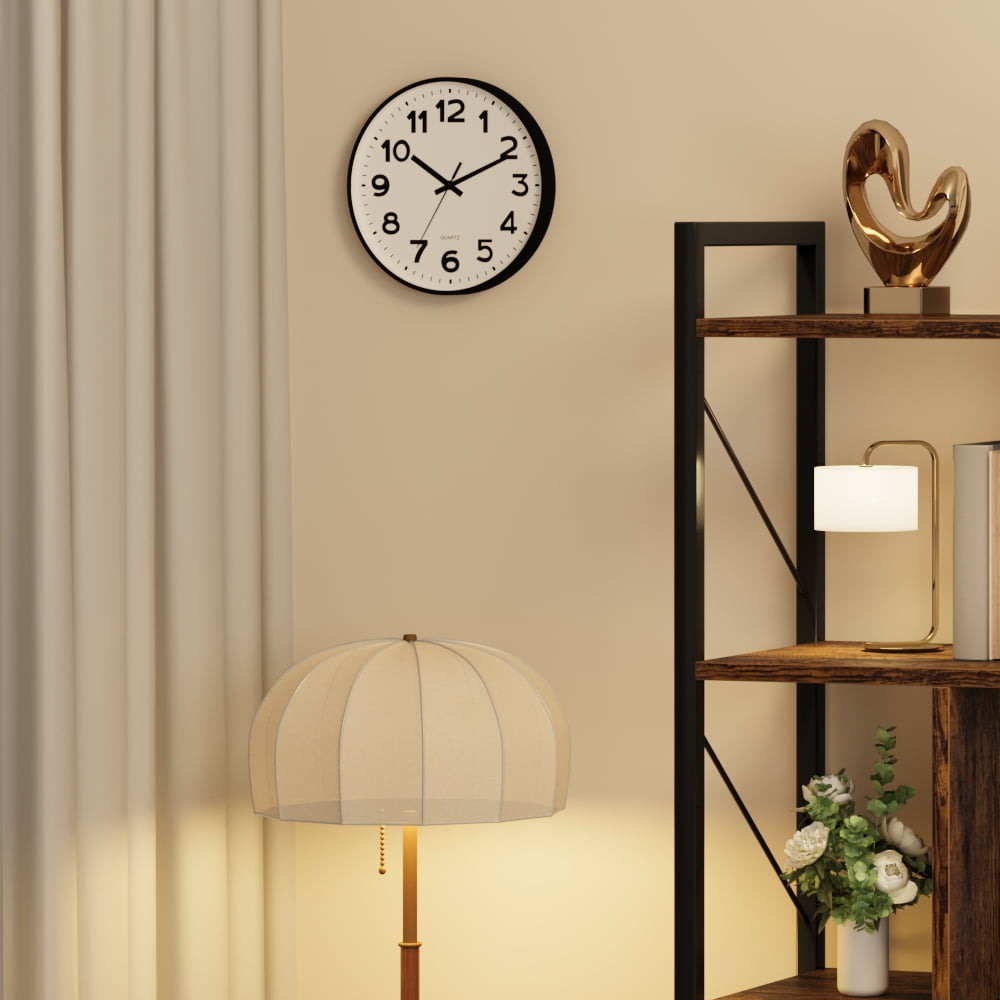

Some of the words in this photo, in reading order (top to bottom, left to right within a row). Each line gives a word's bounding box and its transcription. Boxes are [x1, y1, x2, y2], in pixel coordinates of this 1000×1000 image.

[406, 110, 428, 133] 11
[435, 98, 465, 123] 12
[478, 110, 489, 133] 1
[381, 139, 410, 162] 10
[500, 136, 518, 159] 2
[371, 174, 390, 197] 9
[511, 173, 529, 197] 3
[382, 212, 400, 235] 8
[500, 210, 518, 234] 4
[410, 240, 428, 263] 7
[441, 250, 460, 273] 6
[477, 239, 493, 263] 5
